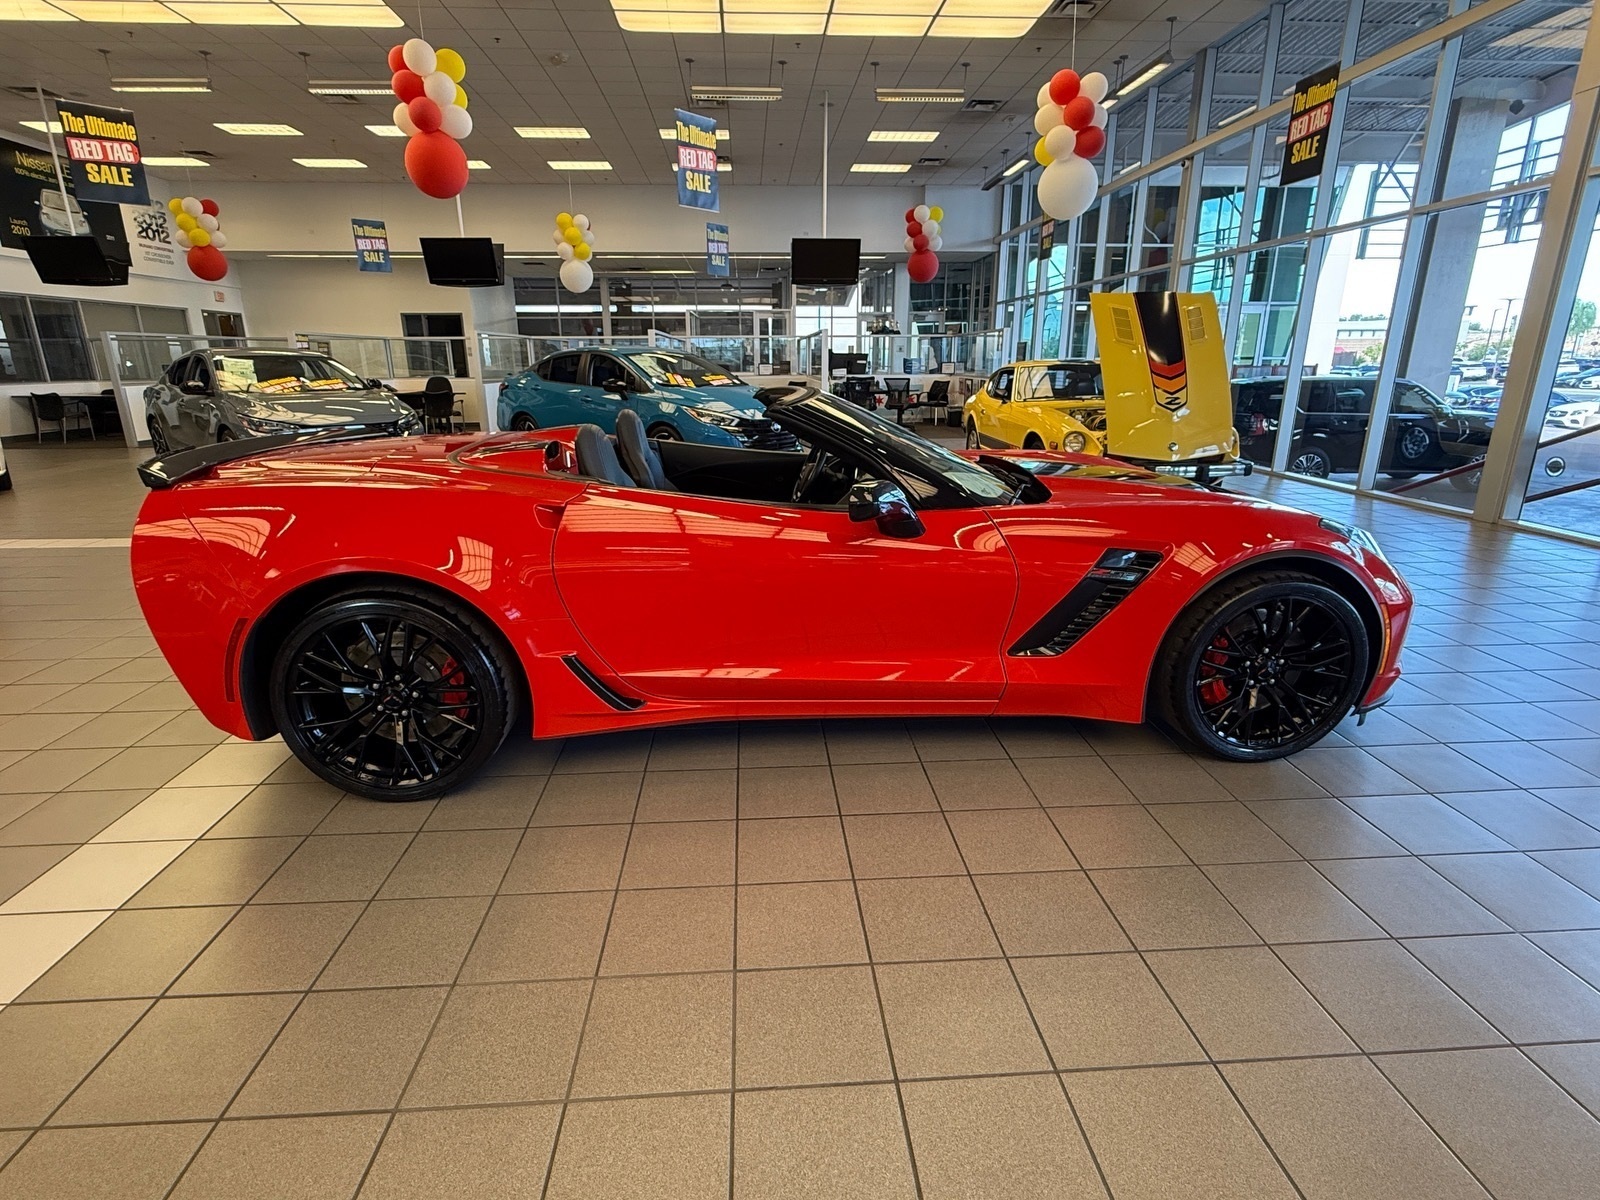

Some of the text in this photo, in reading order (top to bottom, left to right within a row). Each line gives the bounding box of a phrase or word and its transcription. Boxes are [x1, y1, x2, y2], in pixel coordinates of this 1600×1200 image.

[1293, 78, 1337, 114] The Ultimate
[59, 110, 136, 140] The Ultimate
[676, 120, 716, 149] The Ultimate
[1290, 105, 1328, 142] RED TAG
[69, 139, 134, 162] RED TAG
[680, 147, 713, 169] RED TAG
[1290, 135, 1320, 164] SALE
[15, 150, 56, 175] Nissan
[85, 162, 133, 186] SALE
[685, 170, 711, 193] SALE
[11, 224, 31, 237] 2010
[136, 224, 172, 245] 2012
[356, 238, 386, 249] RED TAG
[363, 250, 385, 263] SALE
[711, 254, 725, 266] SALE
